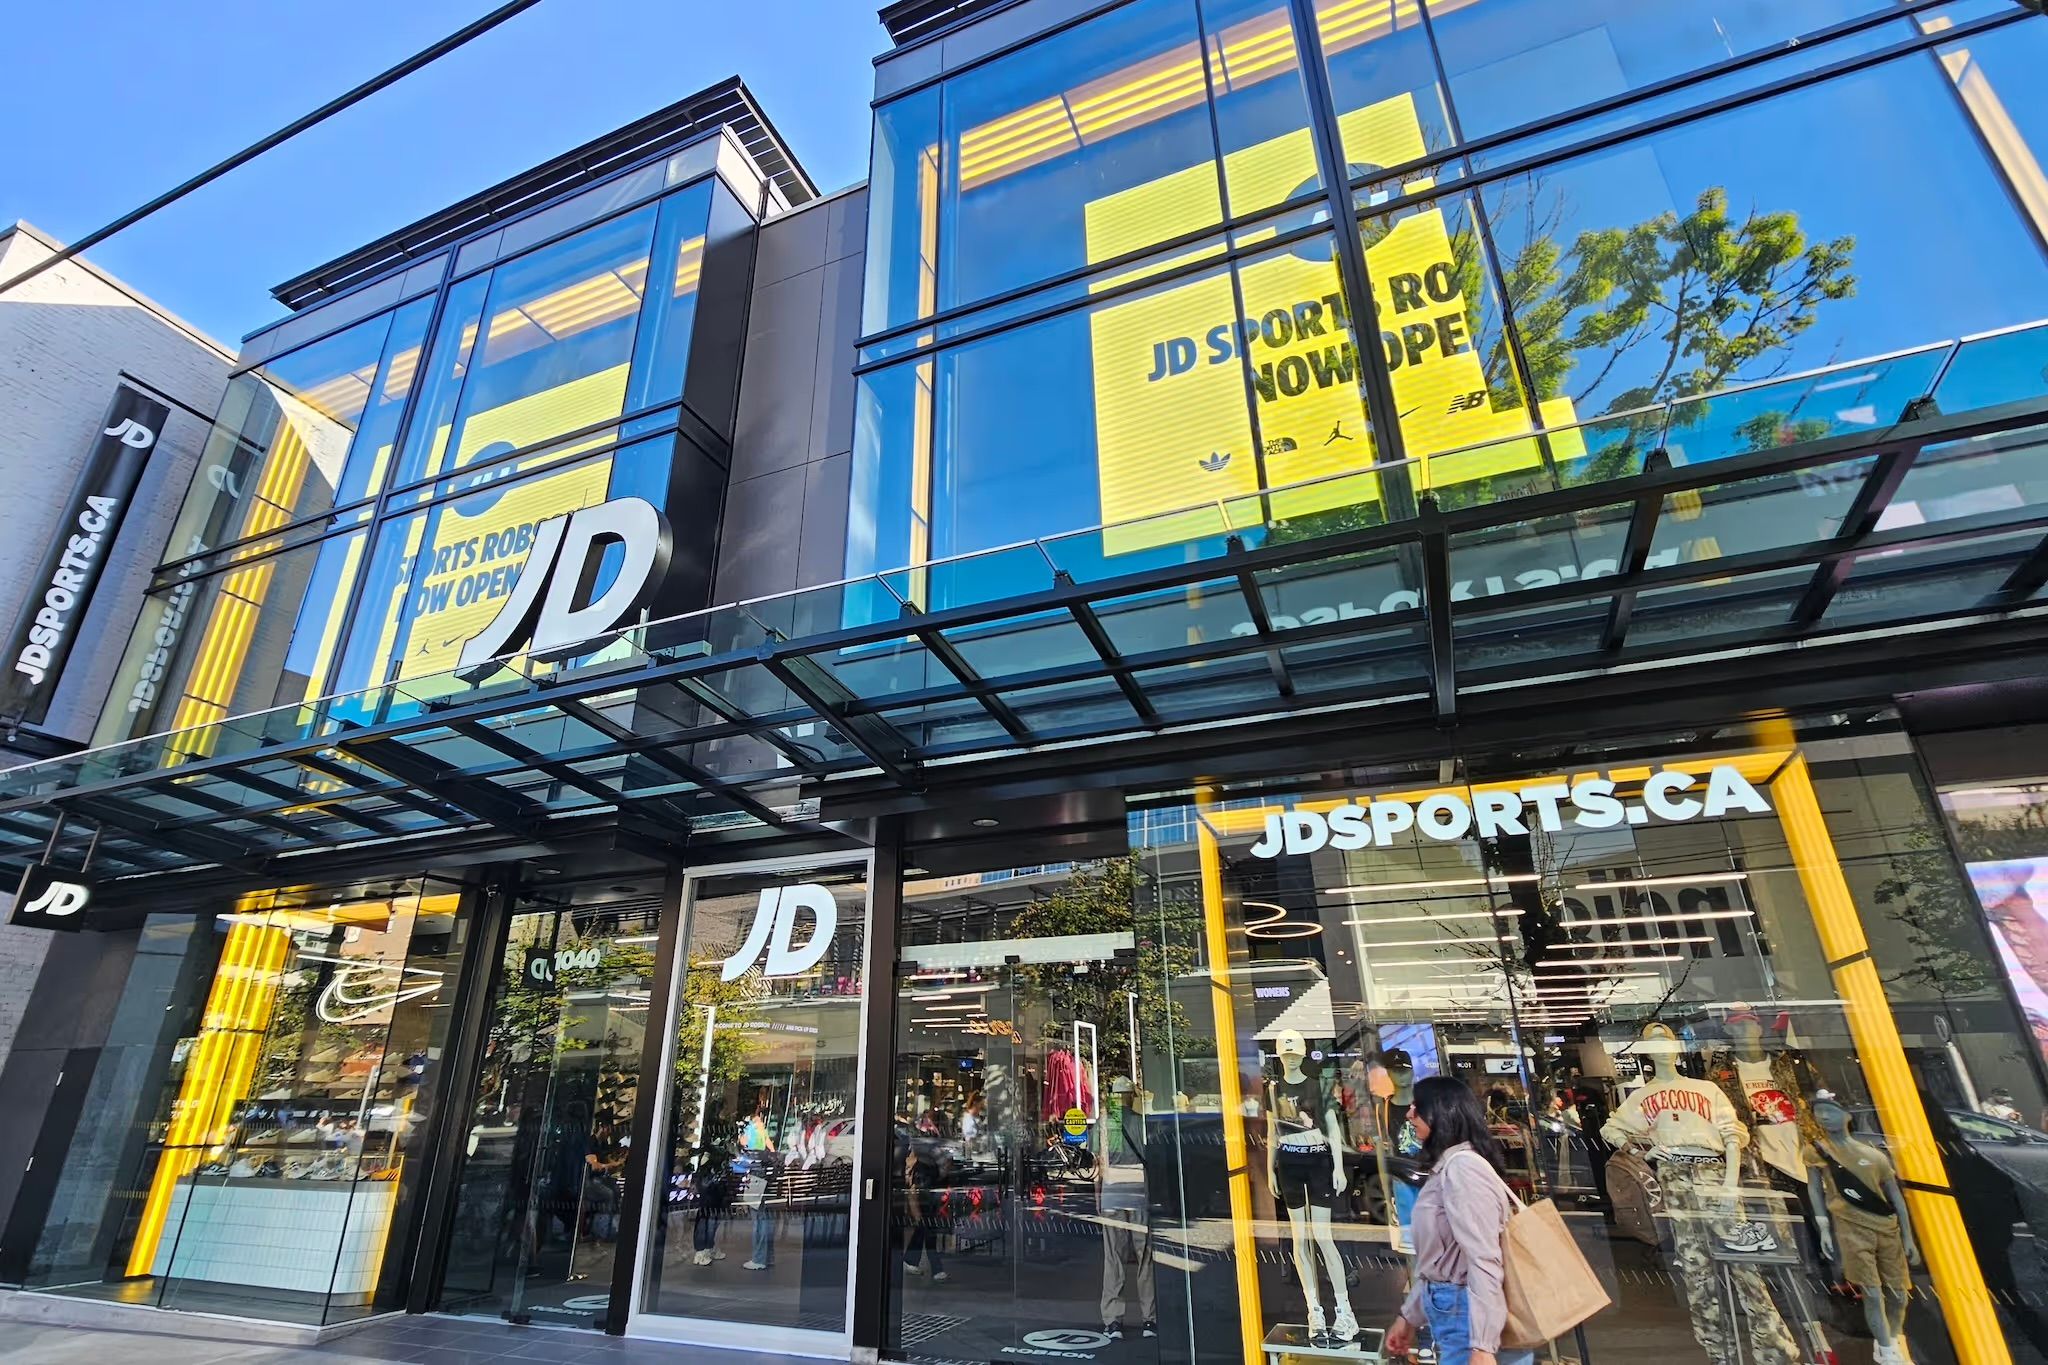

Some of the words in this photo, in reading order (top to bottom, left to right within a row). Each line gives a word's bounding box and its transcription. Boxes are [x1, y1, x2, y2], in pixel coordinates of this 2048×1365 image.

[1148, 336, 1197, 382] JD
[1206, 282, 1381, 365] SPORT
[1252, 341, 1357, 403] NOW
[104, 418, 153, 449] JD
[15, 495, 118, 686] JDSPORTS.CA
[454, 497, 668, 680] JD
[1249, 765, 1773, 859] JDSPORTS.CA
[24, 881, 88, 916] JD
[721, 884, 838, 982] JD
[554, 948, 601, 971] 1040
[1255, 986, 1290, 998] WOMENS
[1282, 1144, 1309, 1154] NIKE
[1000, 1346, 1096, 1360] ROBSON
[1031, 1333, 1101, 1345] JD
